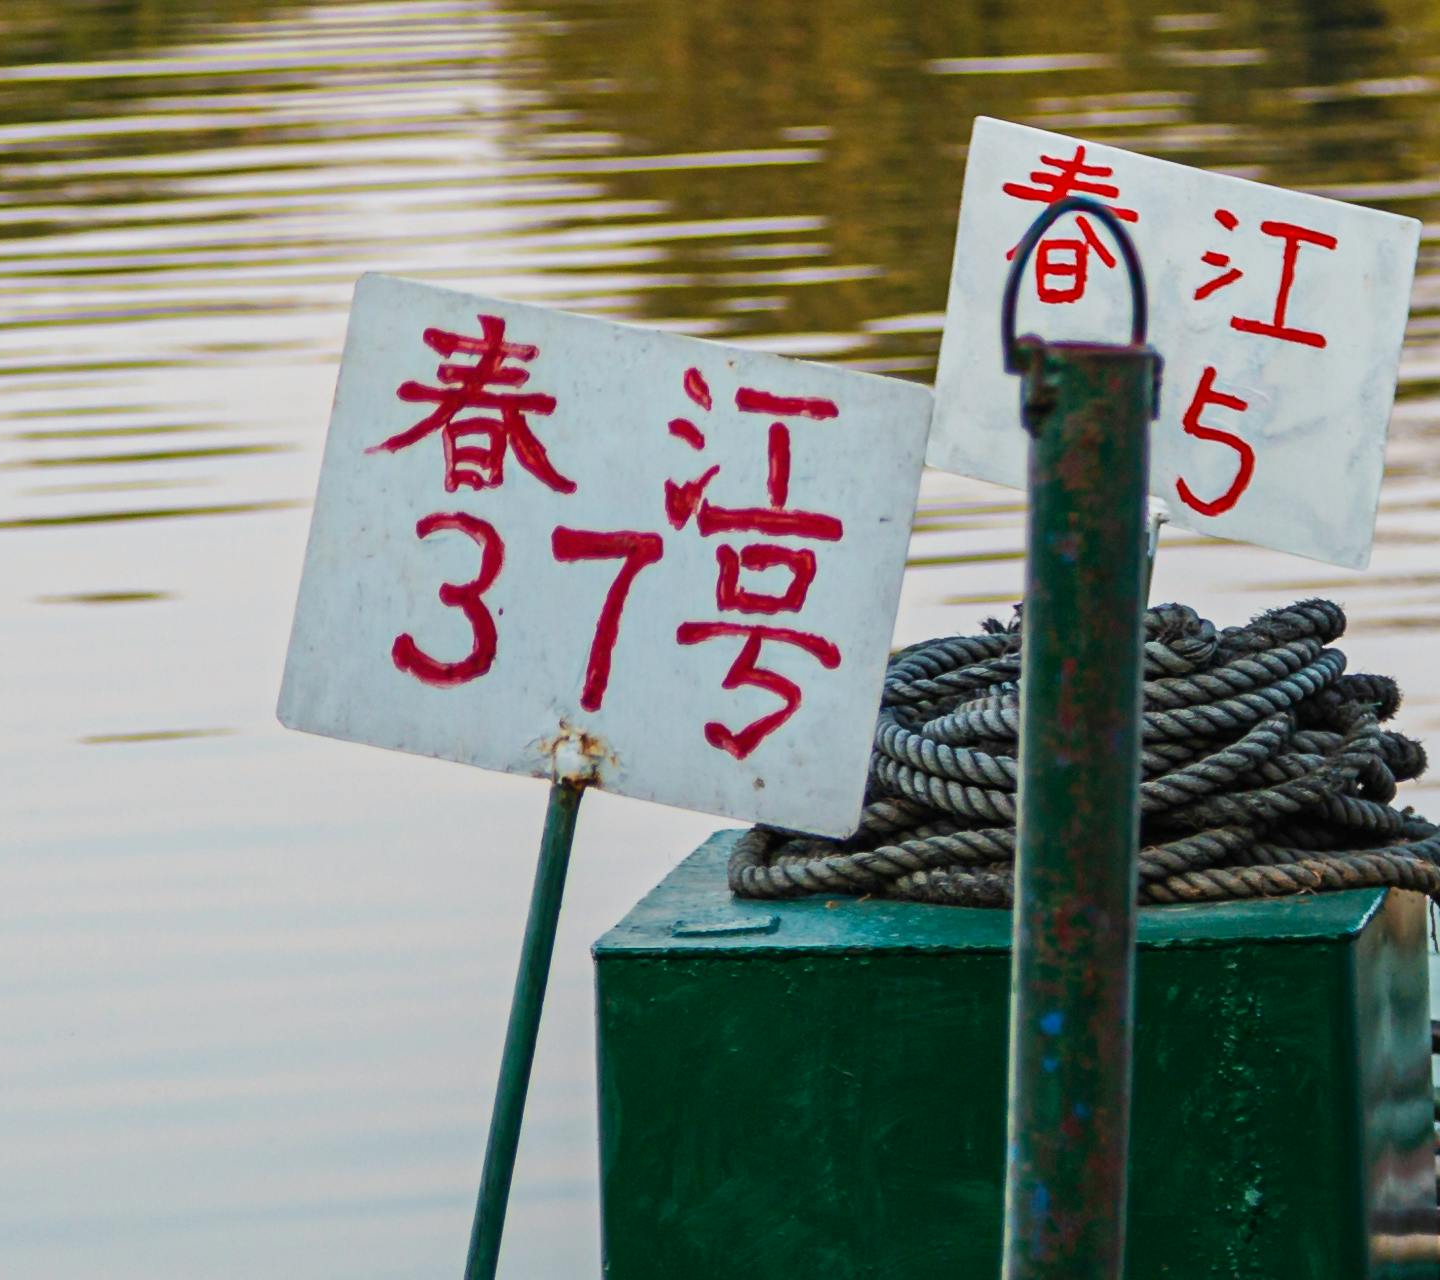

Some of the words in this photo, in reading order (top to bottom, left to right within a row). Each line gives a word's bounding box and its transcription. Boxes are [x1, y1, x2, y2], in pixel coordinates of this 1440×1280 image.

[1001, 143, 1340, 352] 春江
[366, 313, 845, 542] 春江
[1174, 365, 1257, 519] 5
